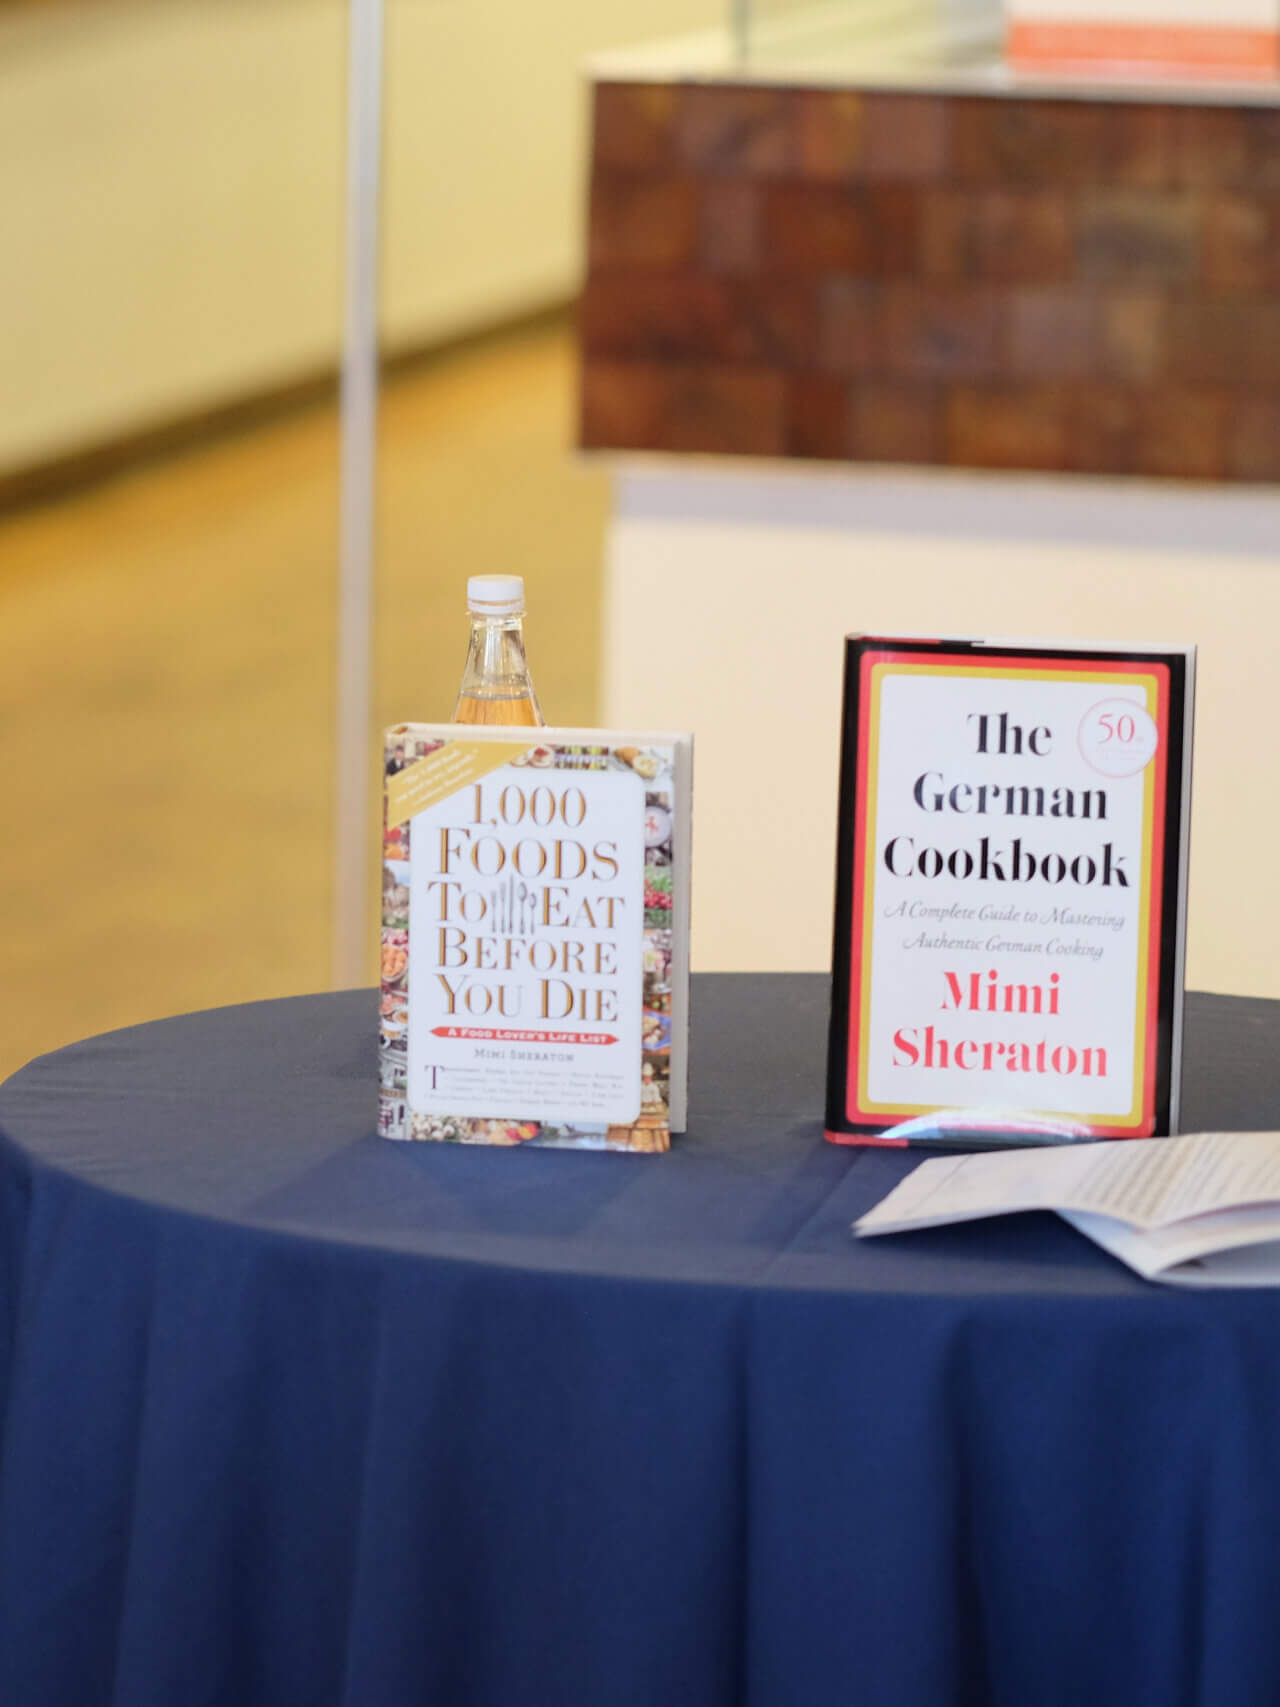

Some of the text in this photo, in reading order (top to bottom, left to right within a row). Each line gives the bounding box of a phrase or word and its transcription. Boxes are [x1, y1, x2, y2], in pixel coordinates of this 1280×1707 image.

[967, 712, 1052, 756] The
[913, 771, 1107, 819] German
[884, 836, 1130, 887] Cookbook
[884, 900, 1126, 931] A Complete Guide to Mastering
[902, 932, 1104, 960] Authentic German Cooking
[939, 969, 1060, 1015] Mimi
[892, 1025, 1107, 1077] Sheraton
